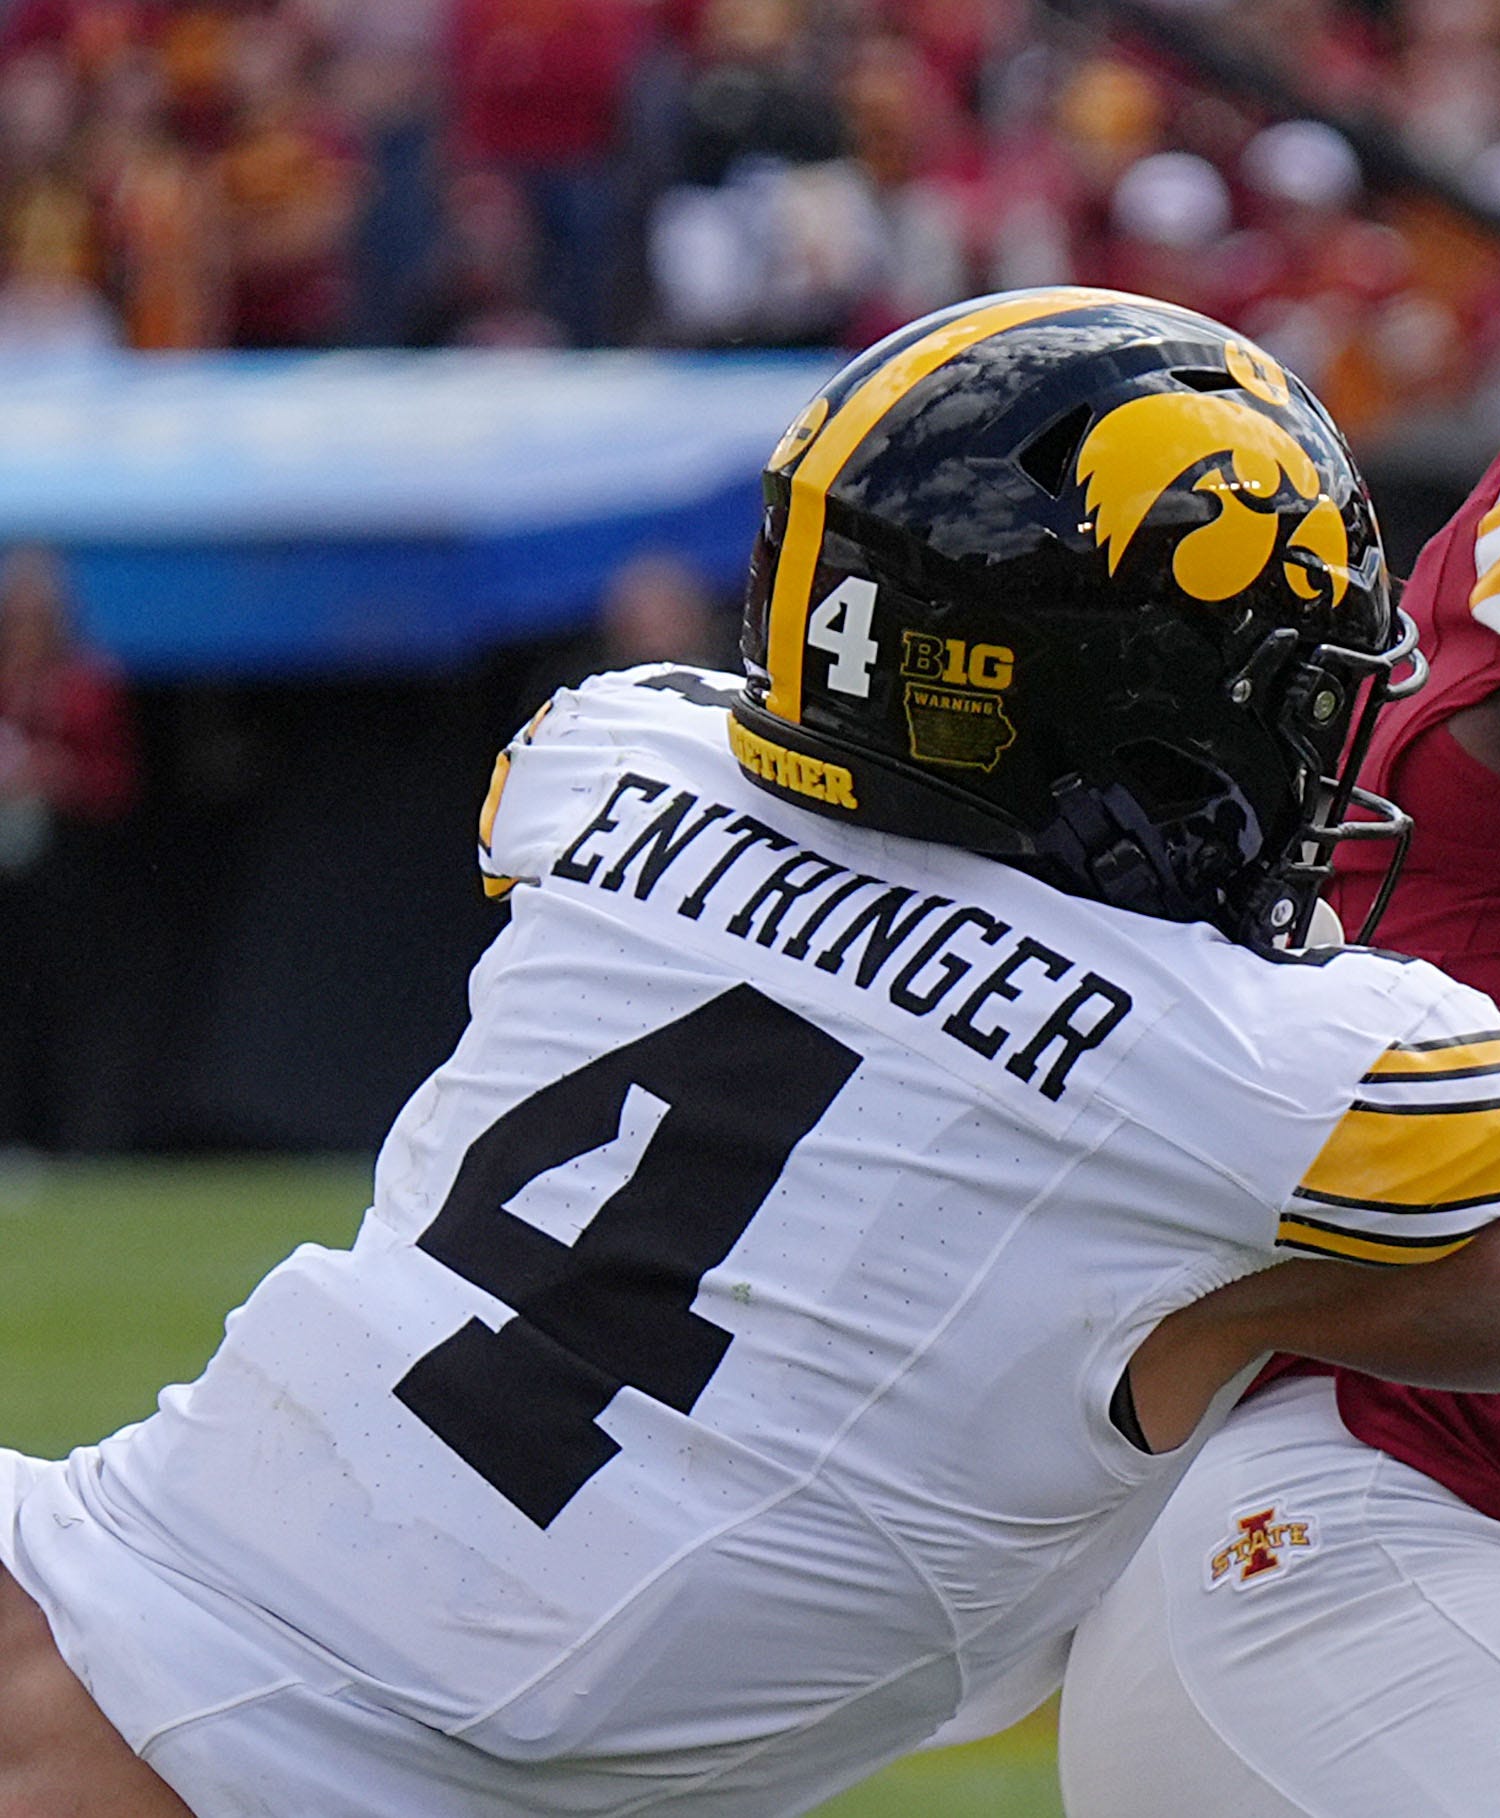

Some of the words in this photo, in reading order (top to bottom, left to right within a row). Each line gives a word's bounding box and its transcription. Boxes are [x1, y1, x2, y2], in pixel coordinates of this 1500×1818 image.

[807, 576, 879, 698] 4
[913, 691, 993, 715] WARNING
[727, 711, 858, 809] ETHER
[551, 772, 1133, 1102] ENTRINGER
[392, 981, 864, 1530] 4
[1211, 1522, 1311, 1580] STATE
